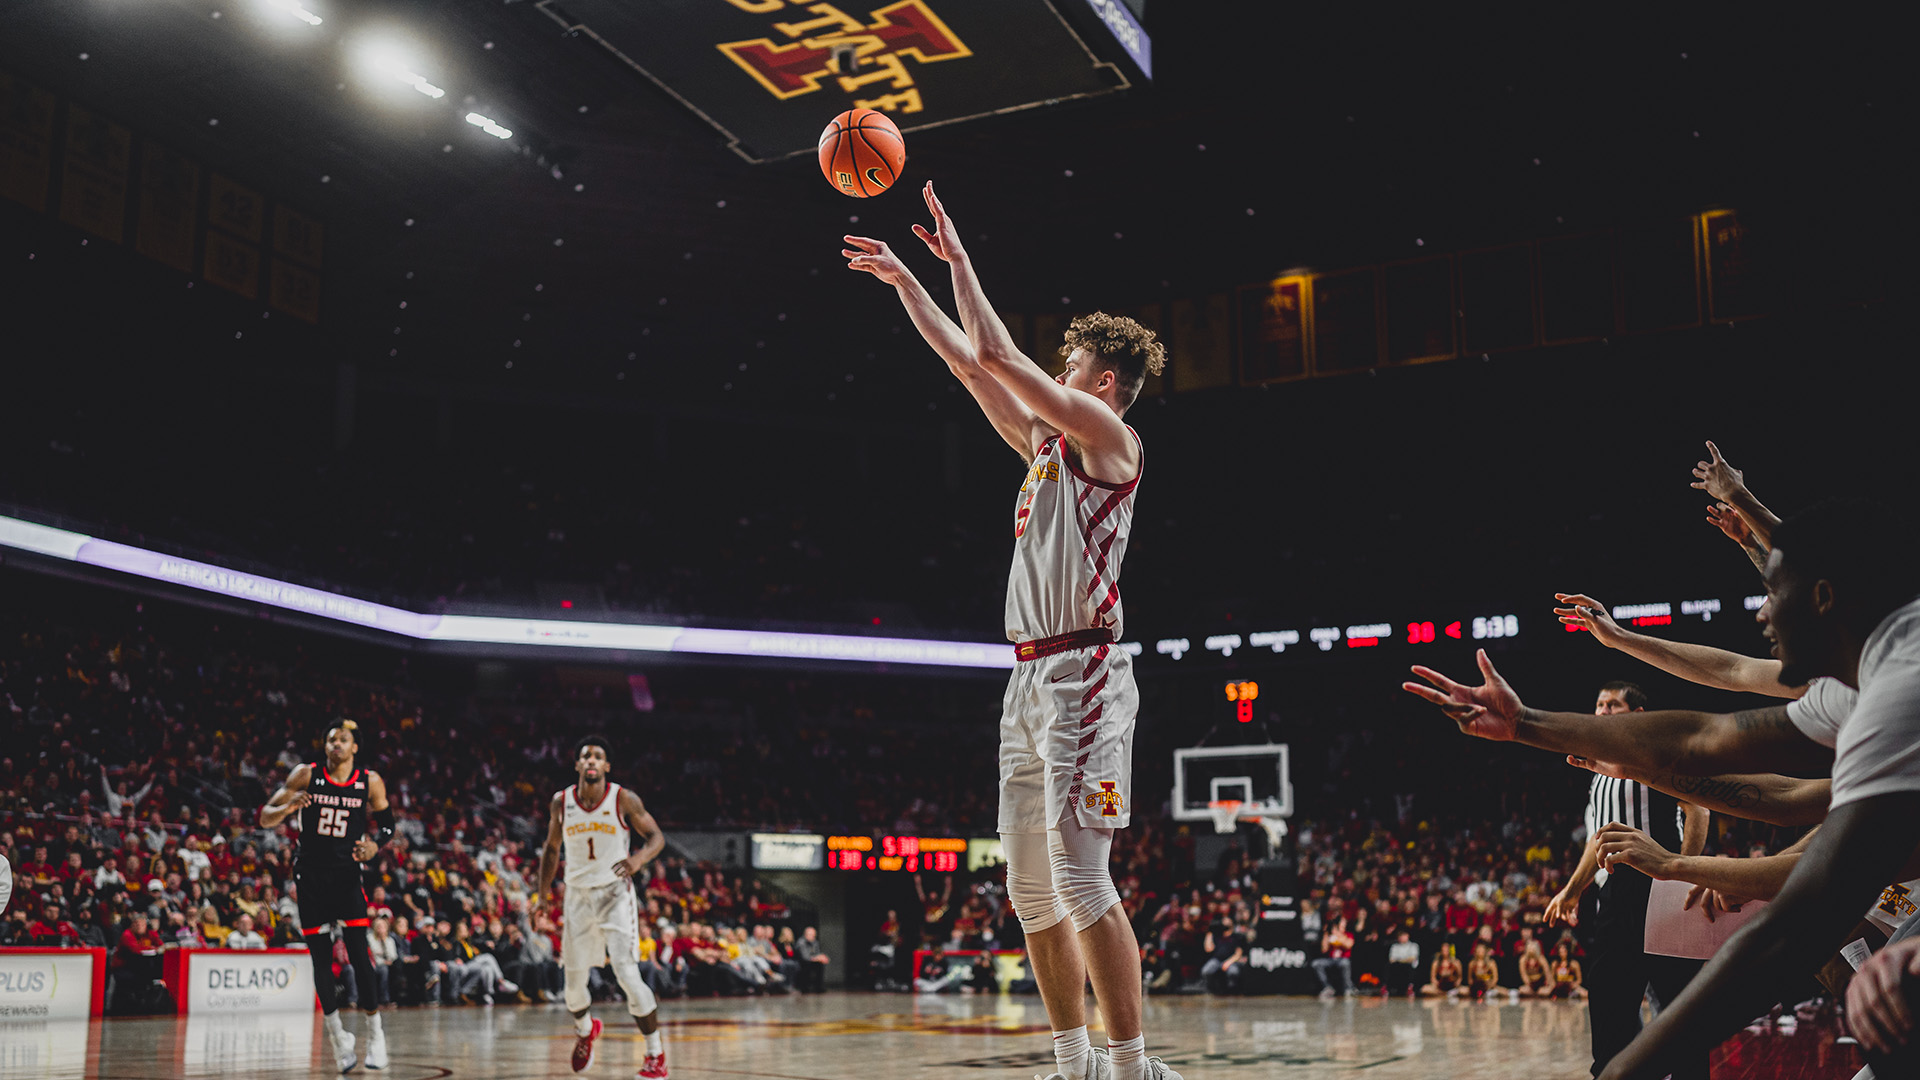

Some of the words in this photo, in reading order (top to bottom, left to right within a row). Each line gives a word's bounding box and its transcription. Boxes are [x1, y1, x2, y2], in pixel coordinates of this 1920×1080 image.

[313, 793, 340, 807] TEXAS
[317, 807, 350, 838] 25
[587, 837, 596, 861] 1
[1880, 889, 1919, 917] TATE
[0, 971, 45, 993] PLUS
[208, 967, 290, 989] DELARO
